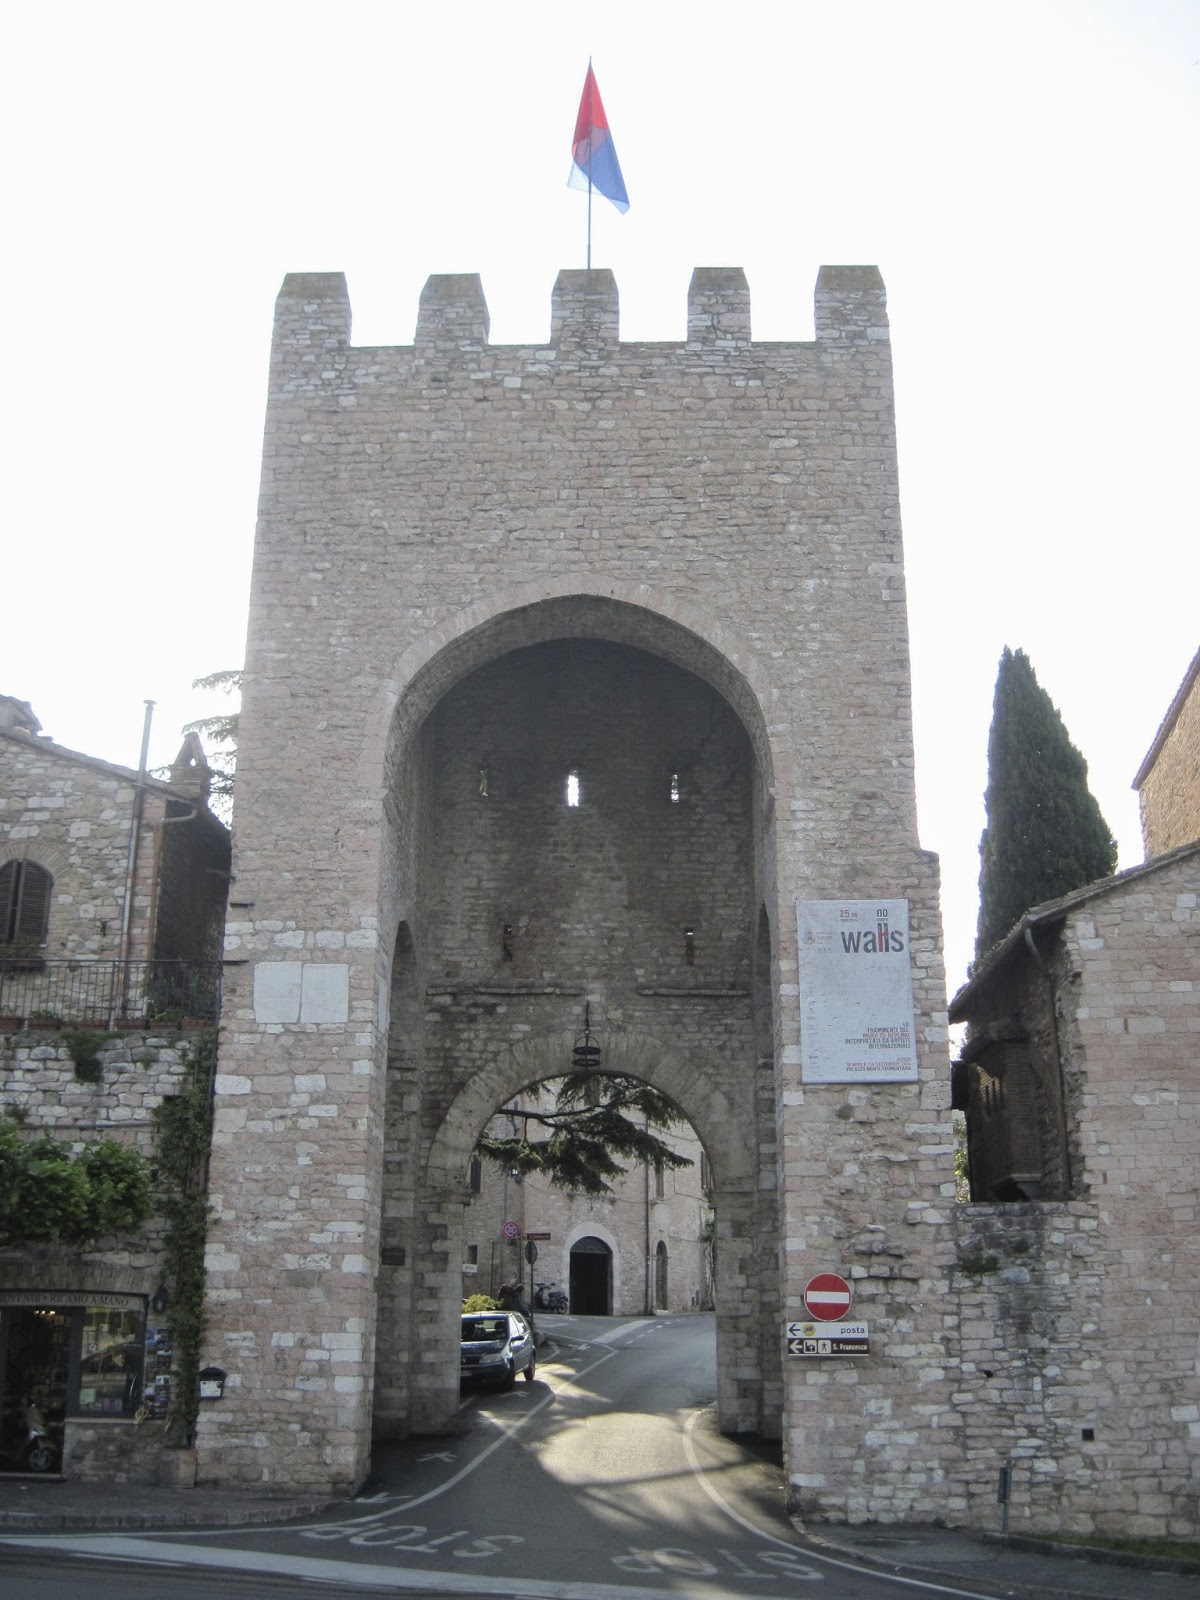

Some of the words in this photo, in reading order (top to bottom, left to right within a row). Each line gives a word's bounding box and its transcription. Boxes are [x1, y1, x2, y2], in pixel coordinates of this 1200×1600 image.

[840, 910, 850, 918] 25
[876, 908, 888, 918] no
[840, 922, 904, 954] walls
[50, 1294, 88, 1304] RICAMO
[90, 1296, 98, 1304] A
[99, 1296, 128, 1306] MANO
[840, 1326, 865, 1334] posta
[299, 1523, 525, 1557] STOP
[611, 1547, 825, 1580] STOP
